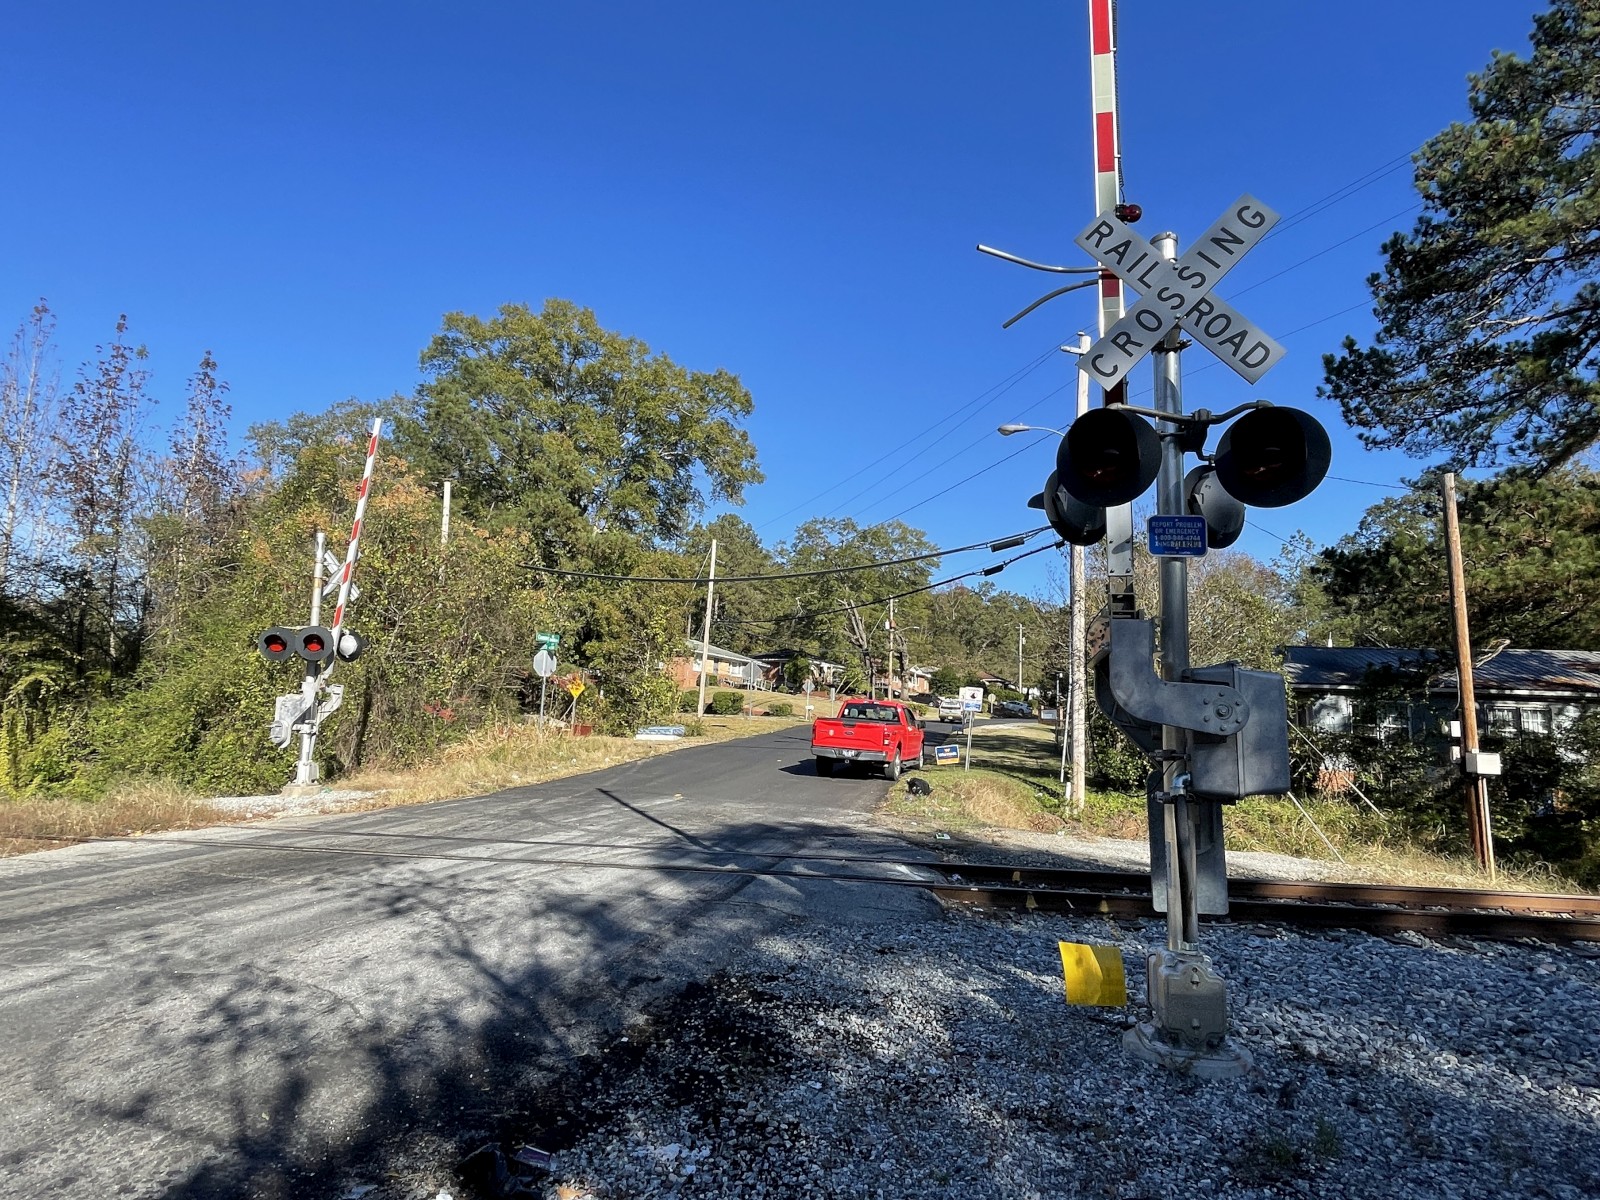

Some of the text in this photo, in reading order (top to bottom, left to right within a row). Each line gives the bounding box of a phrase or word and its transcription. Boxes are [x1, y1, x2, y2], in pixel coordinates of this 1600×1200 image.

[1085, 220, 1271, 369] RAIL ROAD
[1091, 205, 1266, 378] CROSSING
